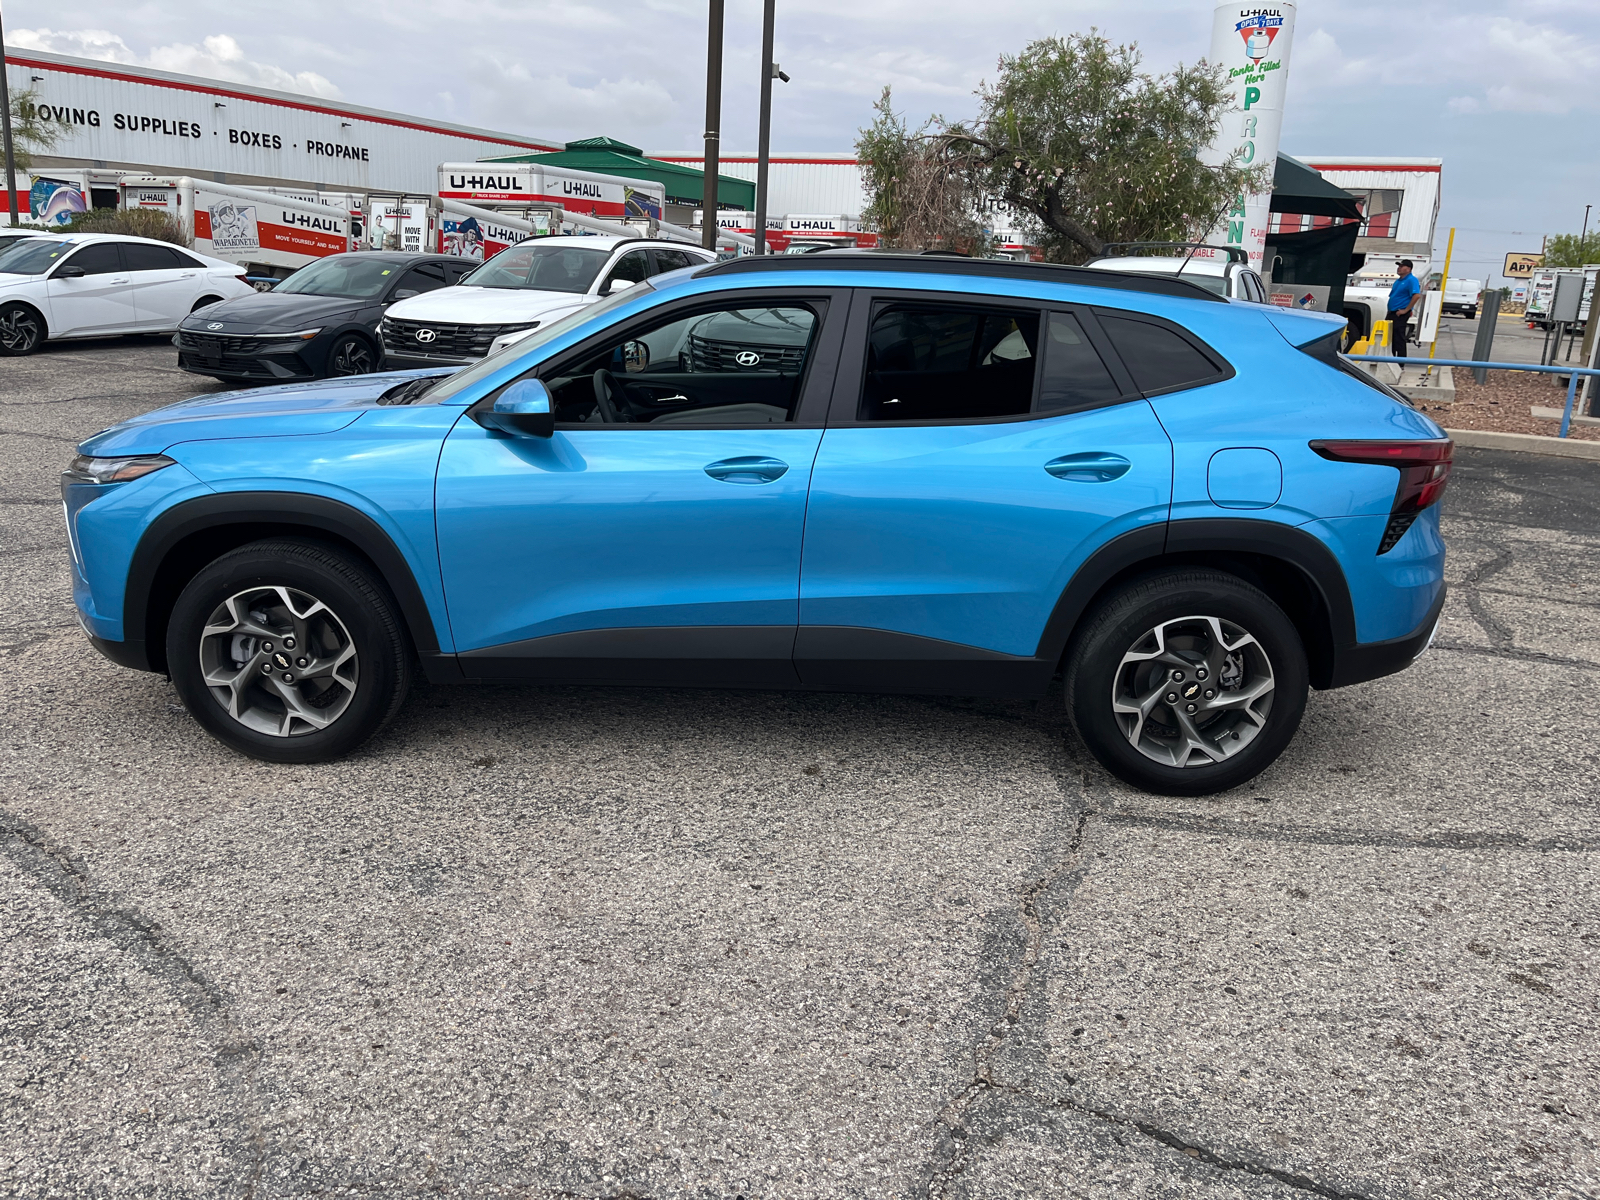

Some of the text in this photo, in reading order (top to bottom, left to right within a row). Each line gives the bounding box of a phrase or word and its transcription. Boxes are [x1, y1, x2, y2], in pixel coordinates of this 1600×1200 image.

[1240, 9, 1282, 18] U-HAUL
[1240, 17, 1259, 28] OPEN
[1229, 59, 1281, 78] Tanks Filled
[1245, 74, 1265, 85] Here
[20, 101, 370, 162] MOVING SUPPLIES BOXES PROPANE
[449, 175, 523, 191] U-HAUL
[563, 180, 602, 198] U-HAUL
[140, 193, 168, 202] U-HAUL
[282, 211, 342, 233] U-HAUL
[790, 221, 836, 230] U-HAUL
[404, 227, 421, 235] MOVE
[291, 236, 316, 246] YOURSELF
[316, 241, 328, 249] AND
[328, 243, 341, 251] SAVE
[405, 244, 420, 252] YOUR
